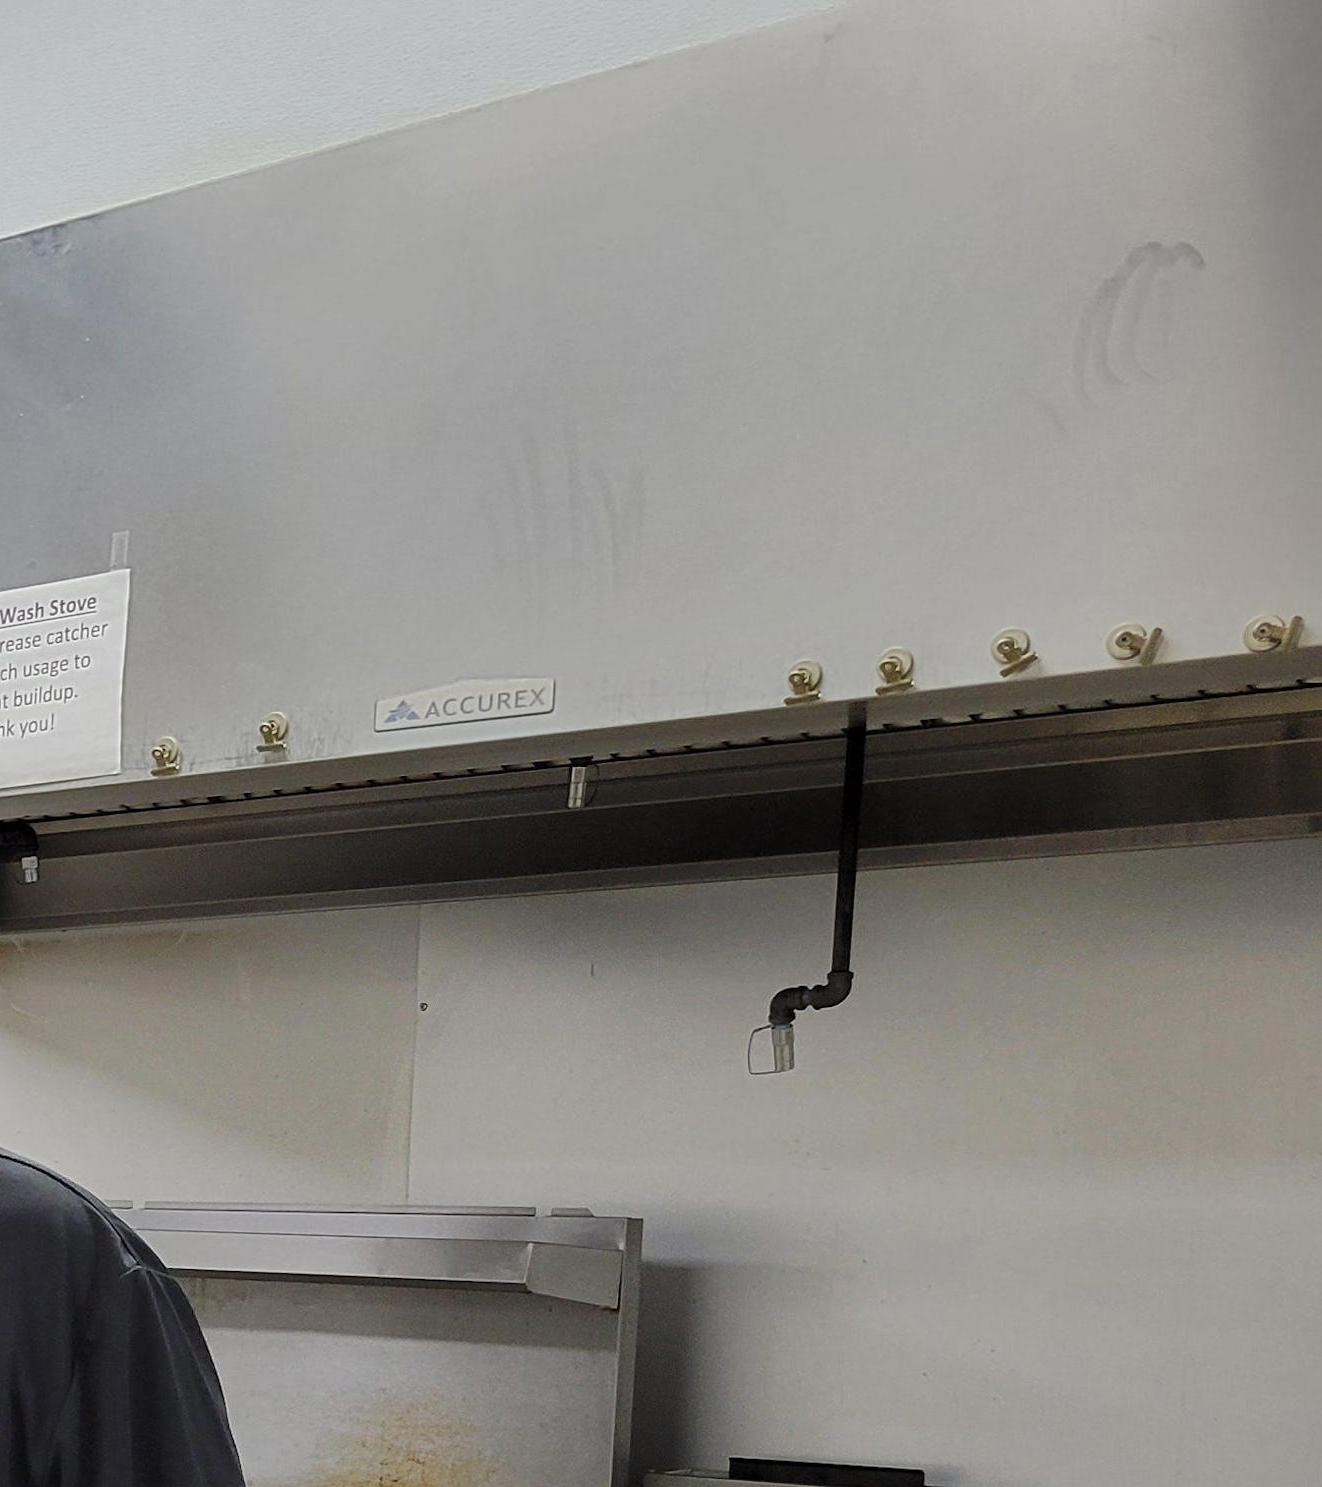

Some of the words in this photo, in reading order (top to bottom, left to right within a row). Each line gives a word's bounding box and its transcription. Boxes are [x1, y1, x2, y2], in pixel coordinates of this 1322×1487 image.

[49, 595, 97, 617] Stove
[46, 622, 109, 646] catcher
[23, 659, 69, 682] usage
[74, 653, 92, 670] to
[13, 686, 78, 709] buildup.
[424, 687, 546, 719] ACCUREX
[19, 714, 55, 738] you!
